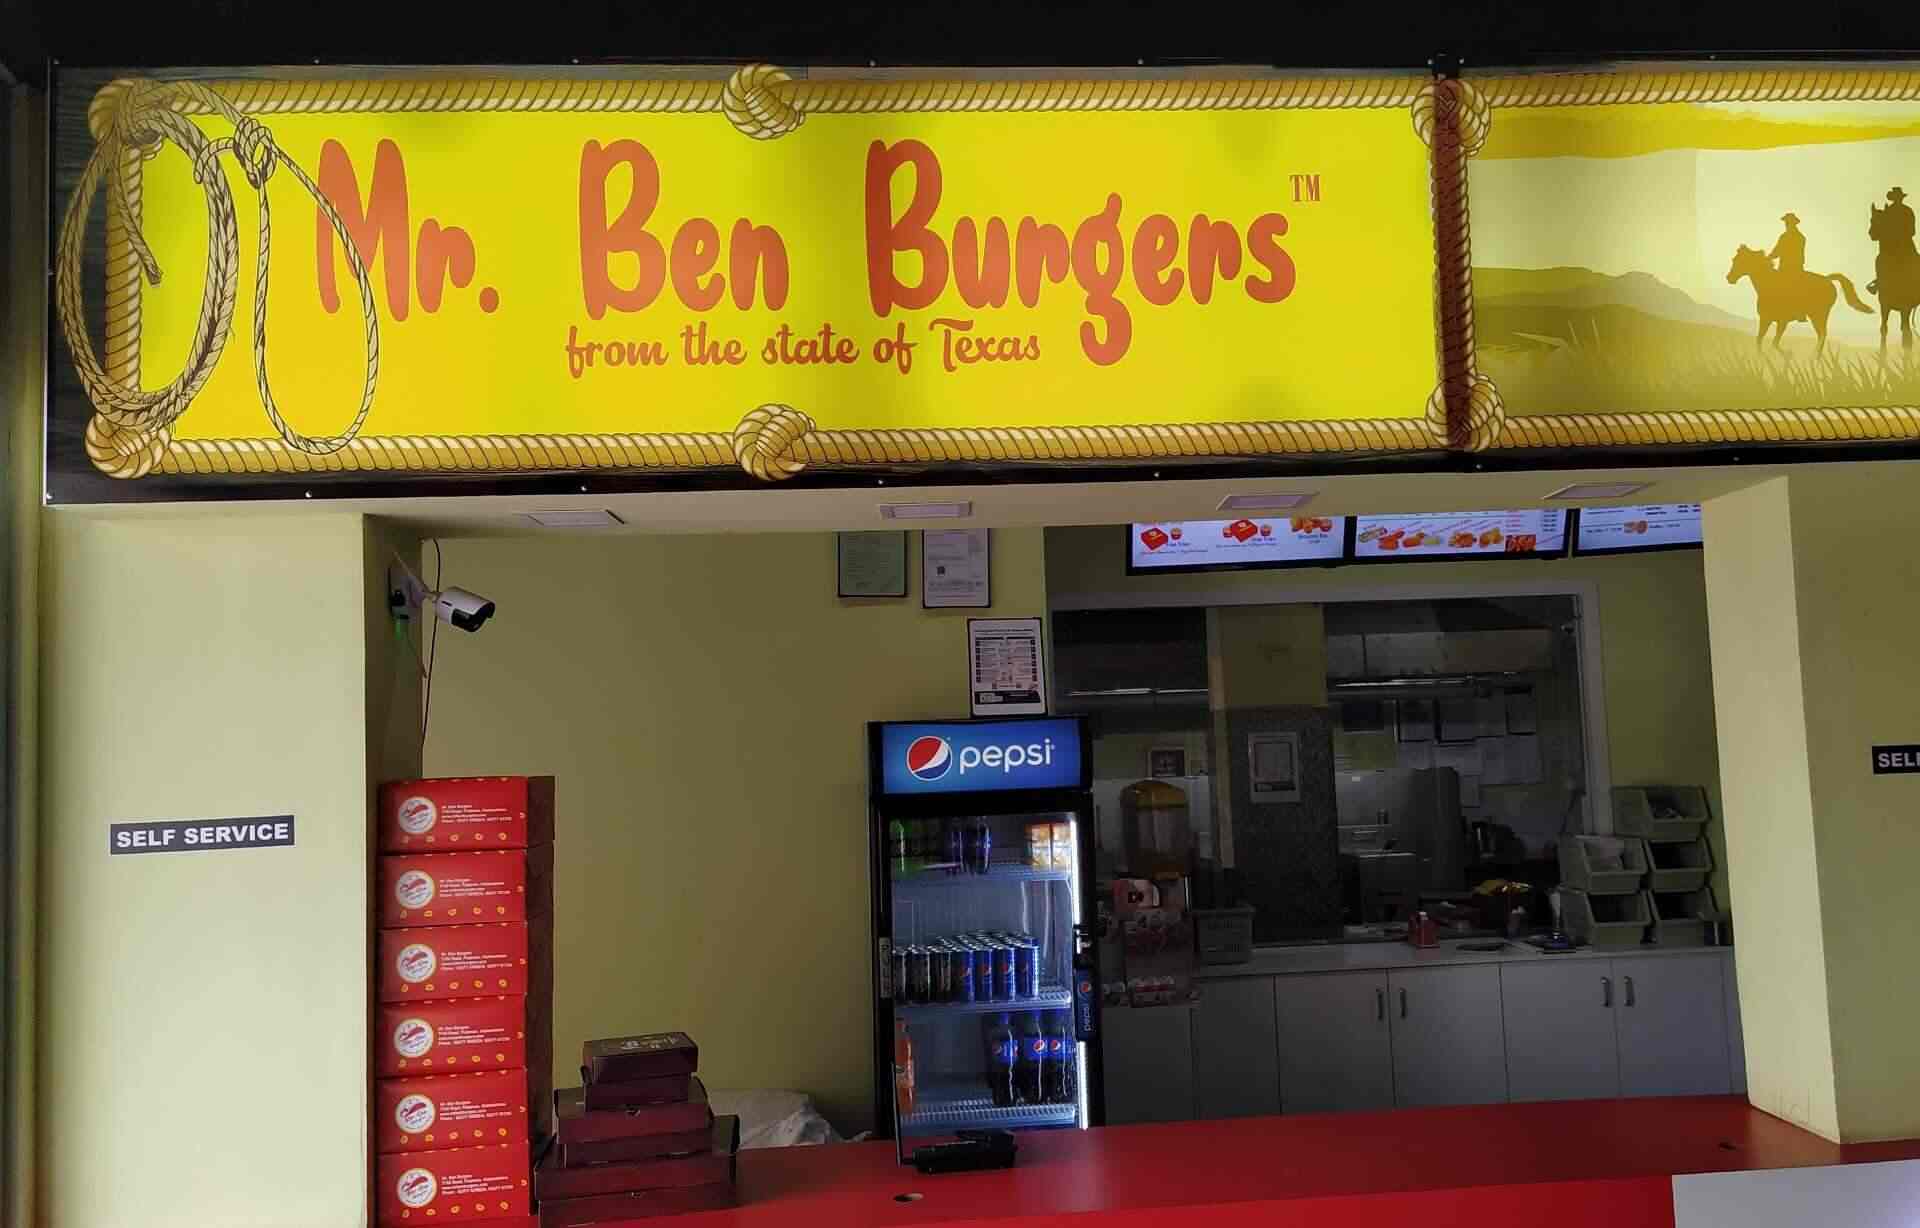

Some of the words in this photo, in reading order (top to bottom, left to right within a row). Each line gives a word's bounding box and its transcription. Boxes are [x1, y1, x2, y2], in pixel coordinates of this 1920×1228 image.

[1288, 173, 1321, 203] TM
[315, 138, 500, 322] Mr.
[578, 137, 790, 321] Ben
[864, 138, 1297, 367] Burgers
[565, 325, 669, 379] from
[679, 321, 748, 366] the
[760, 322, 861, 367] state
[872, 321, 917, 375] of
[928, 317, 1041, 372] Texas
[958, 738, 1053, 775] pepsi
[116, 829, 176, 848] SELF
[183, 823, 289, 844] SERVICE
